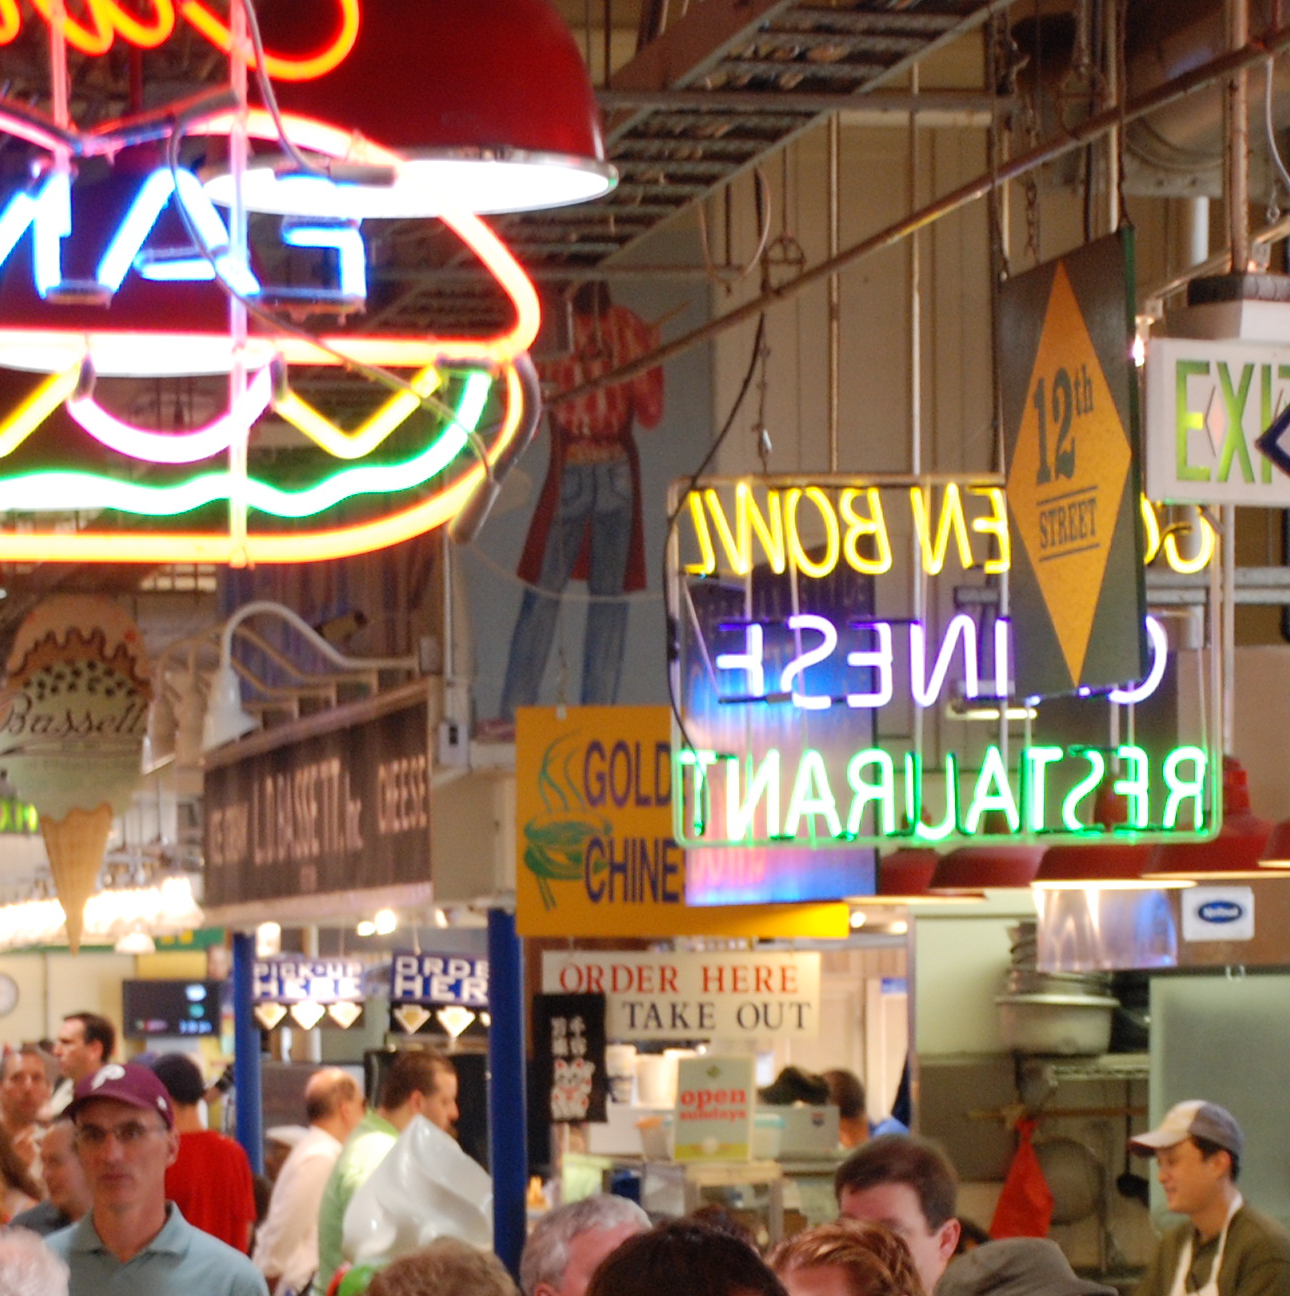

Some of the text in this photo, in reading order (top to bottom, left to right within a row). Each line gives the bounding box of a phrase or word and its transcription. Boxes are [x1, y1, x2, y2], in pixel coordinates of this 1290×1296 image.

[1040, 498, 1098, 549] STREET
[583, 739, 673, 807] GOLD
[584, 838, 687, 904] CHINE
[395, 956, 489, 978] ORDE
[560, 963, 799, 994] ORDER HERE
[253, 977, 362, 999] HERE
[394, 975, 489, 1003] HER
[621, 1001, 812, 1031] TAKE OUT
[680, 1086, 747, 1110] open
